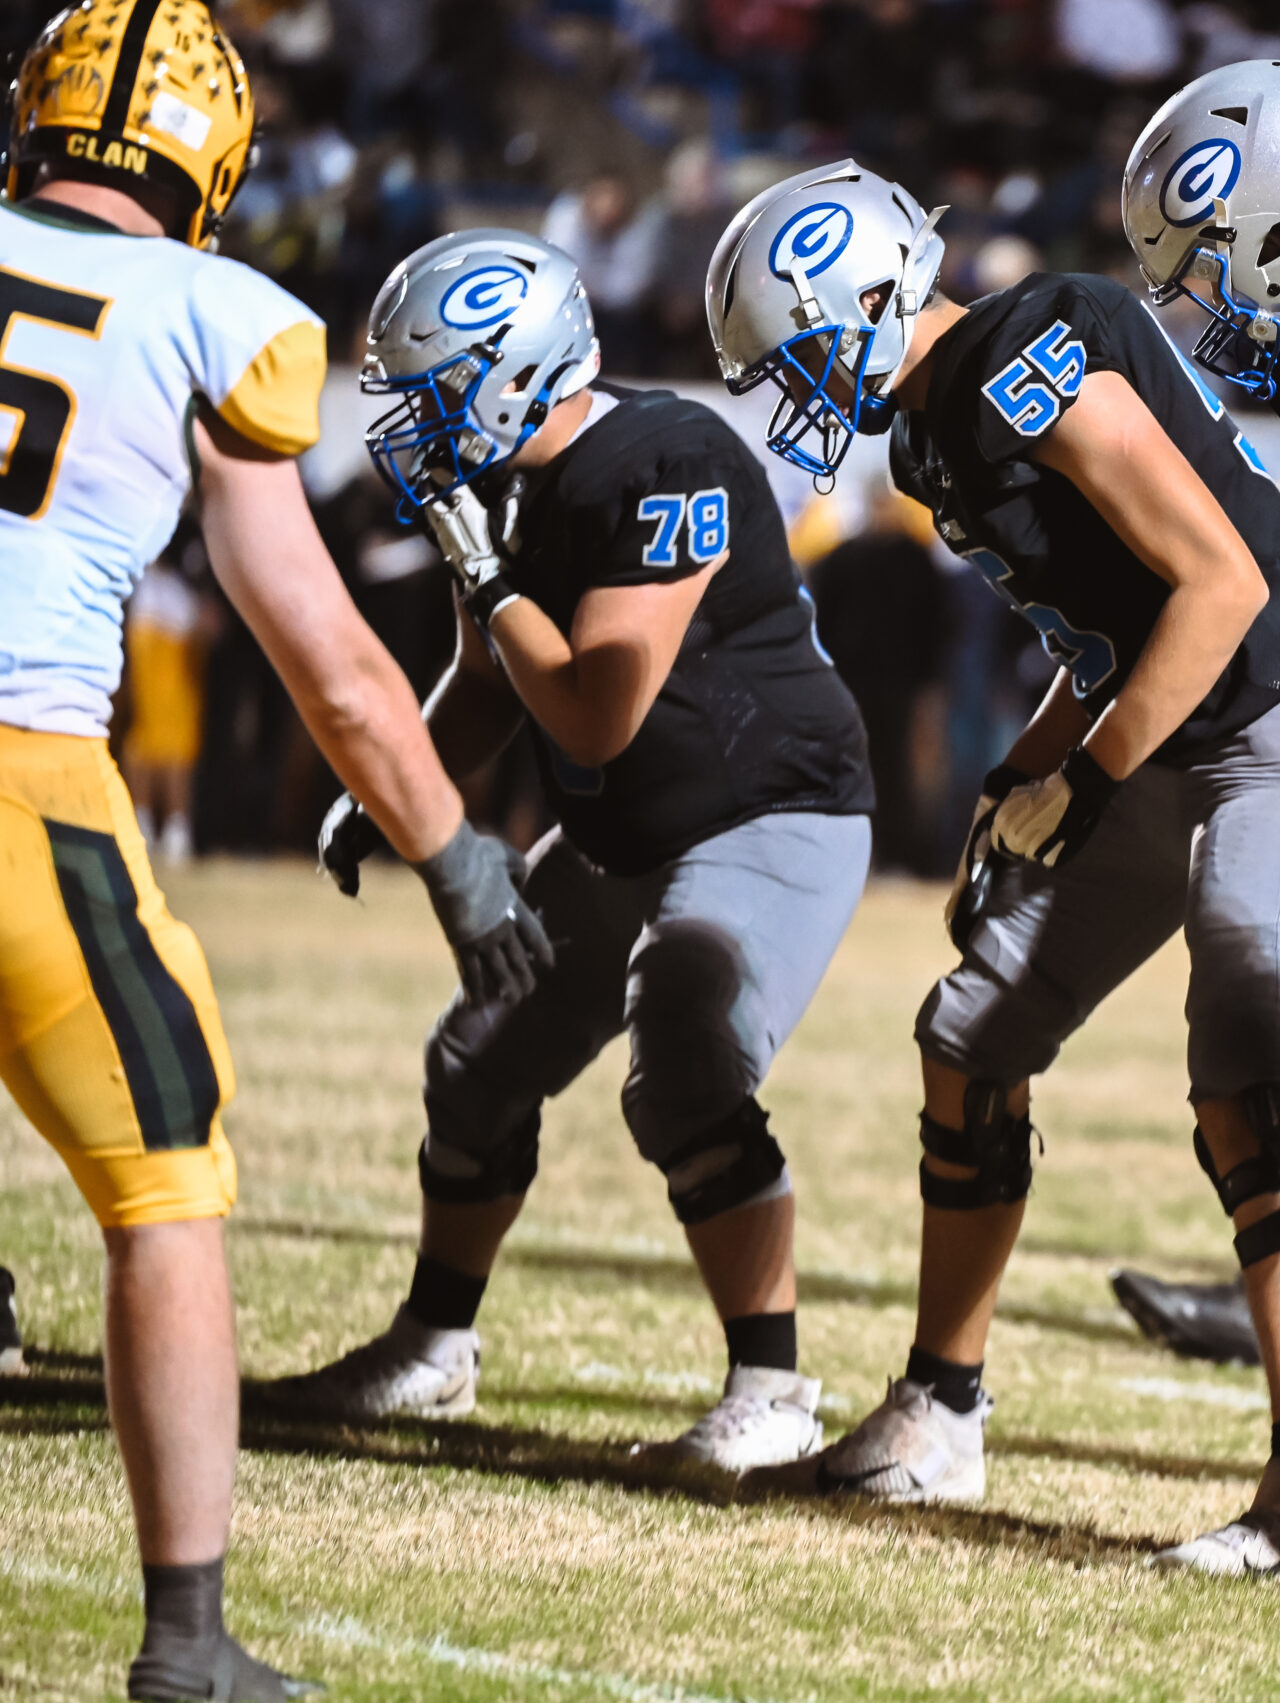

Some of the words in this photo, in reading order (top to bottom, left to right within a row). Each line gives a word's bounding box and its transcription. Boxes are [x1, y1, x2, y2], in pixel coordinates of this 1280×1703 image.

[67, 133, 148, 175] CLAN
[440, 266, 528, 331] G
[980, 319, 1087, 437] 55
[637, 487, 729, 567] 78
